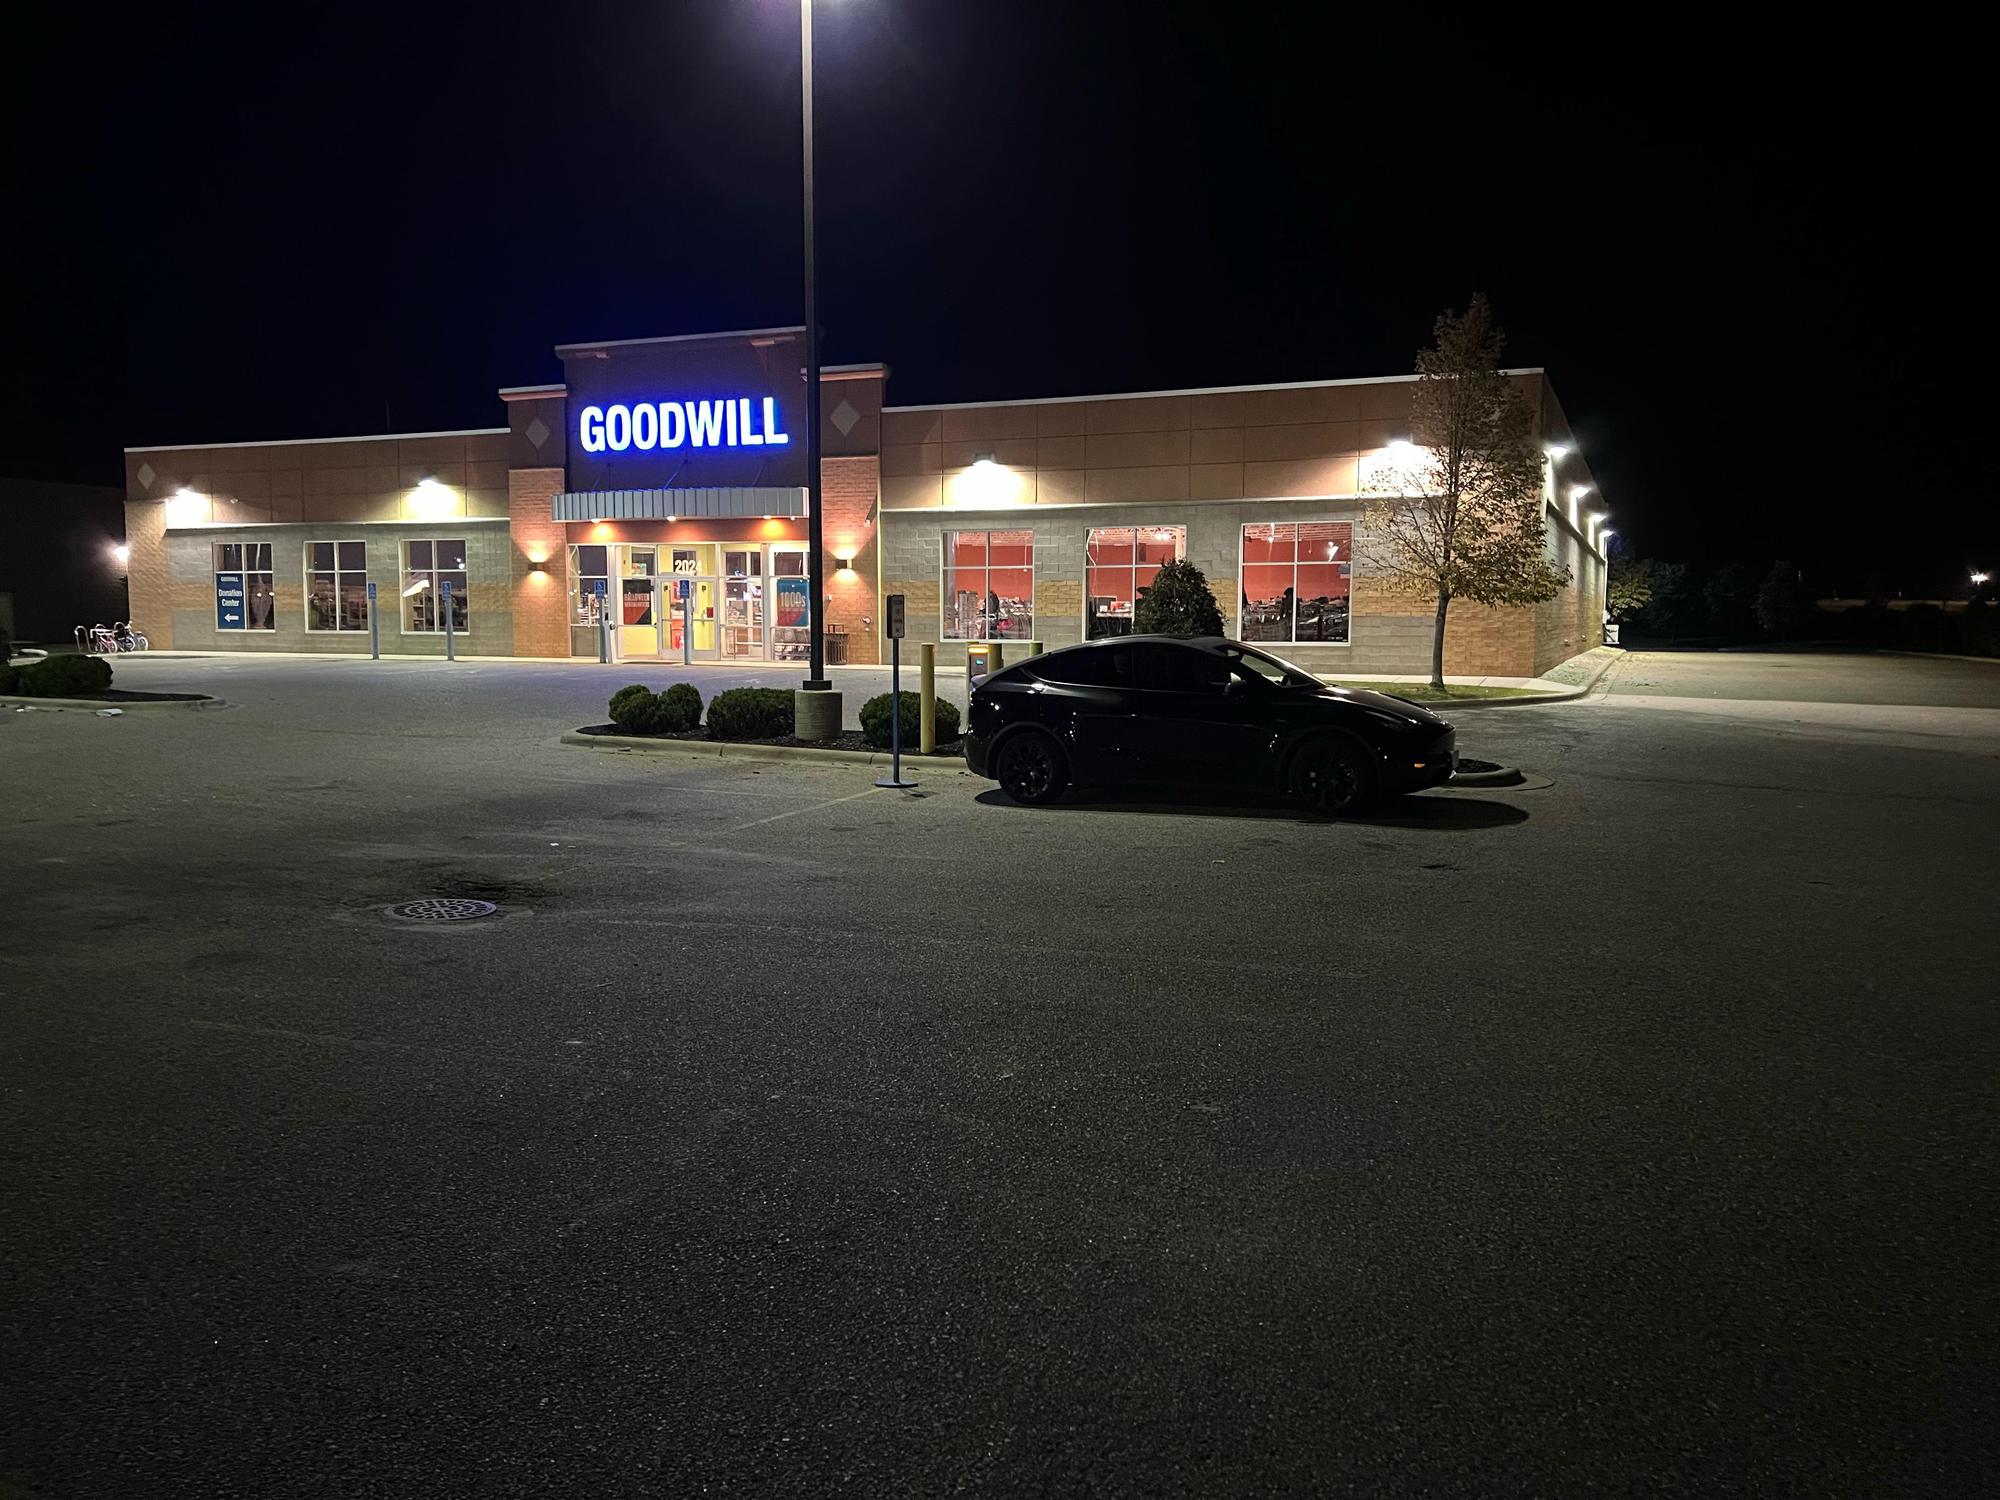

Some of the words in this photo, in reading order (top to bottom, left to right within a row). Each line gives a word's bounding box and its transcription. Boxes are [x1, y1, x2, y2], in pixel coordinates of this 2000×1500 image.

[580, 397, 789, 452] GOODWILL
[674, 559, 702, 575] 2024
[218, 589, 242, 597] Donation
